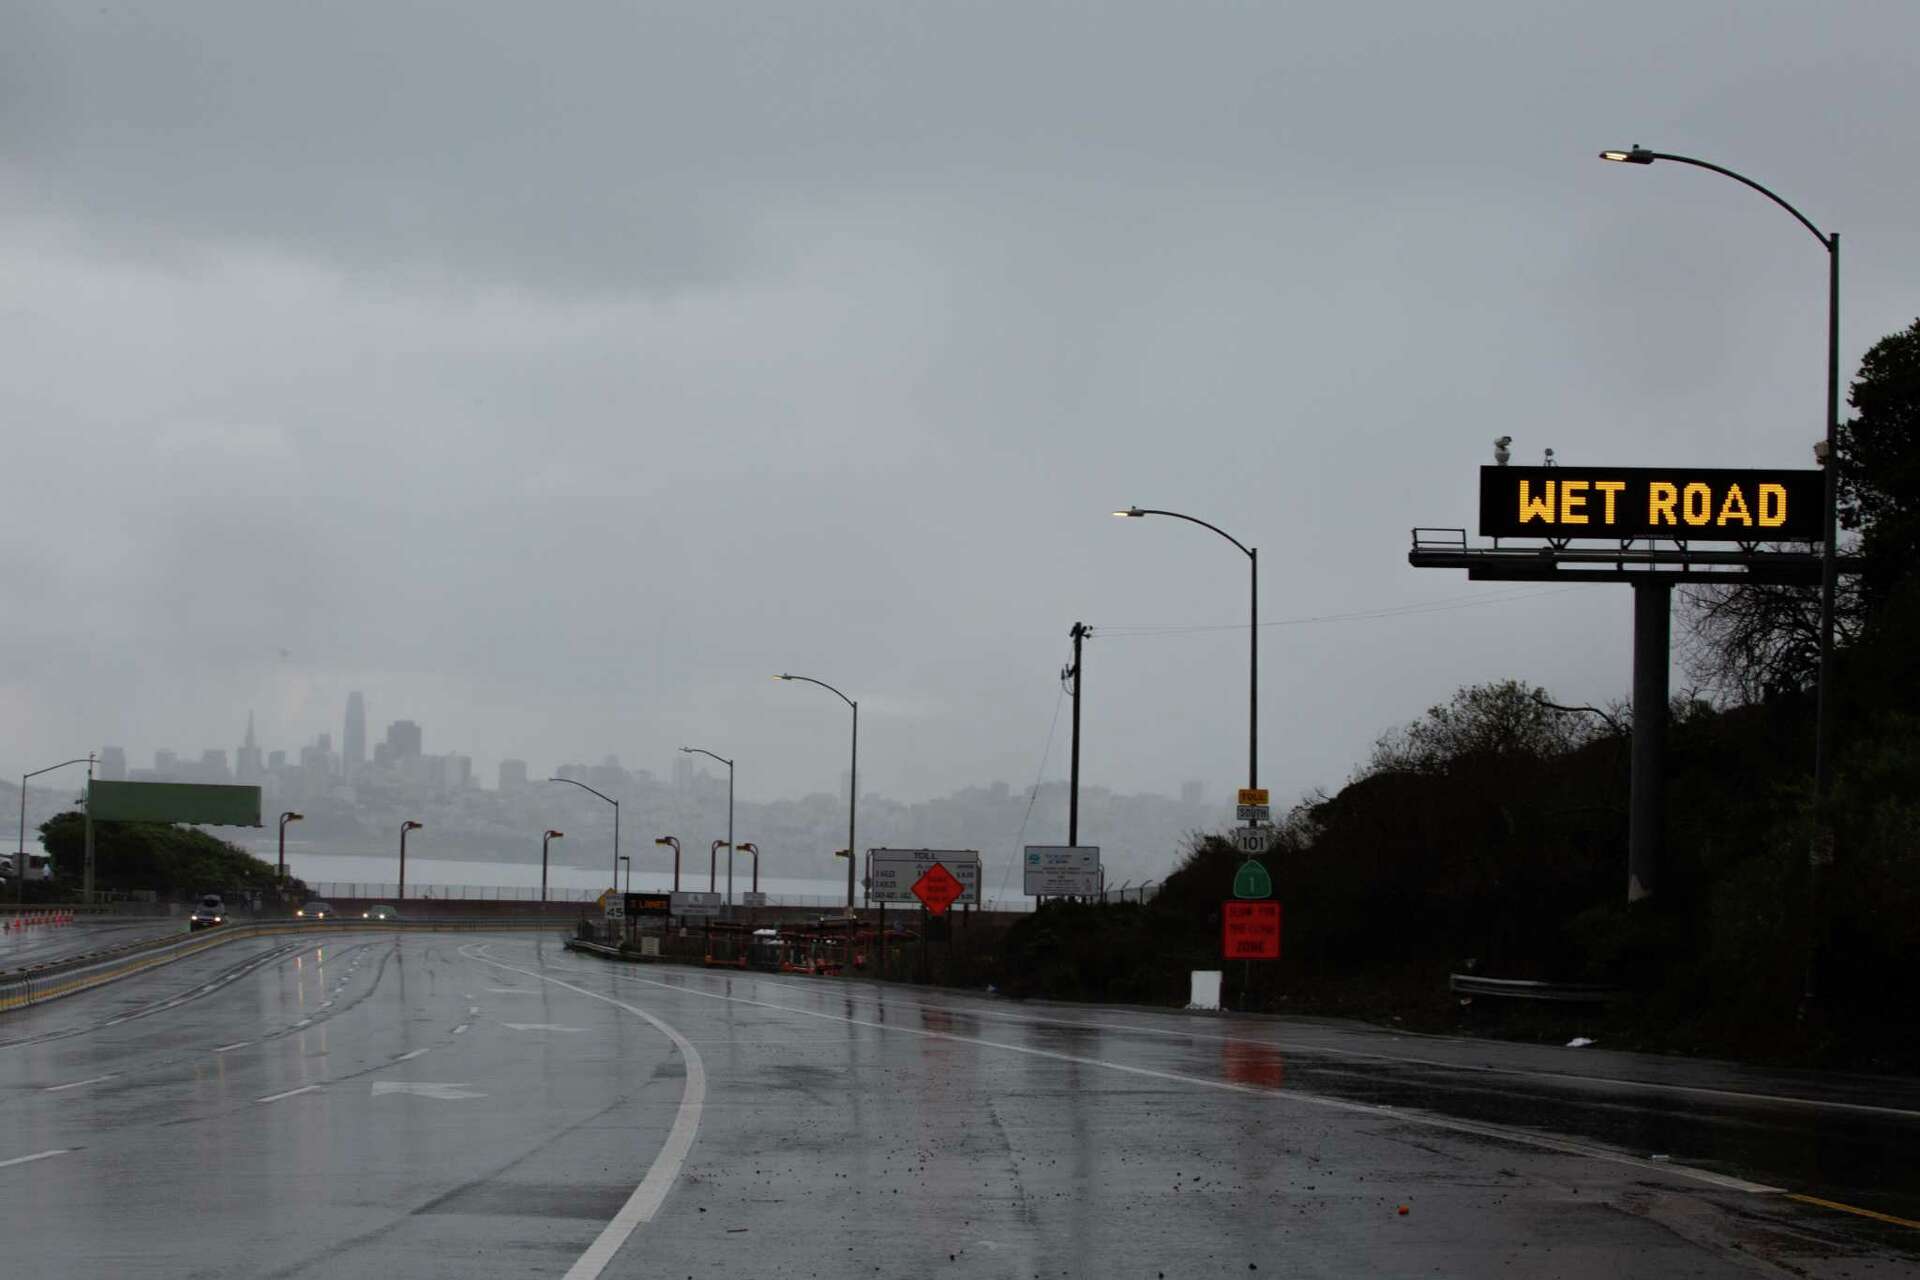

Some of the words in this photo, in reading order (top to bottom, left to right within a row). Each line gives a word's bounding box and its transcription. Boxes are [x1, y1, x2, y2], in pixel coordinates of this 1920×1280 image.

[1519, 480, 1626, 524] WET
[1649, 482, 1787, 527] ROAD
[1239, 807, 1267, 818] SOUTH
[1242, 836, 1264, 850] 101
[607, 907, 623, 918] 45
